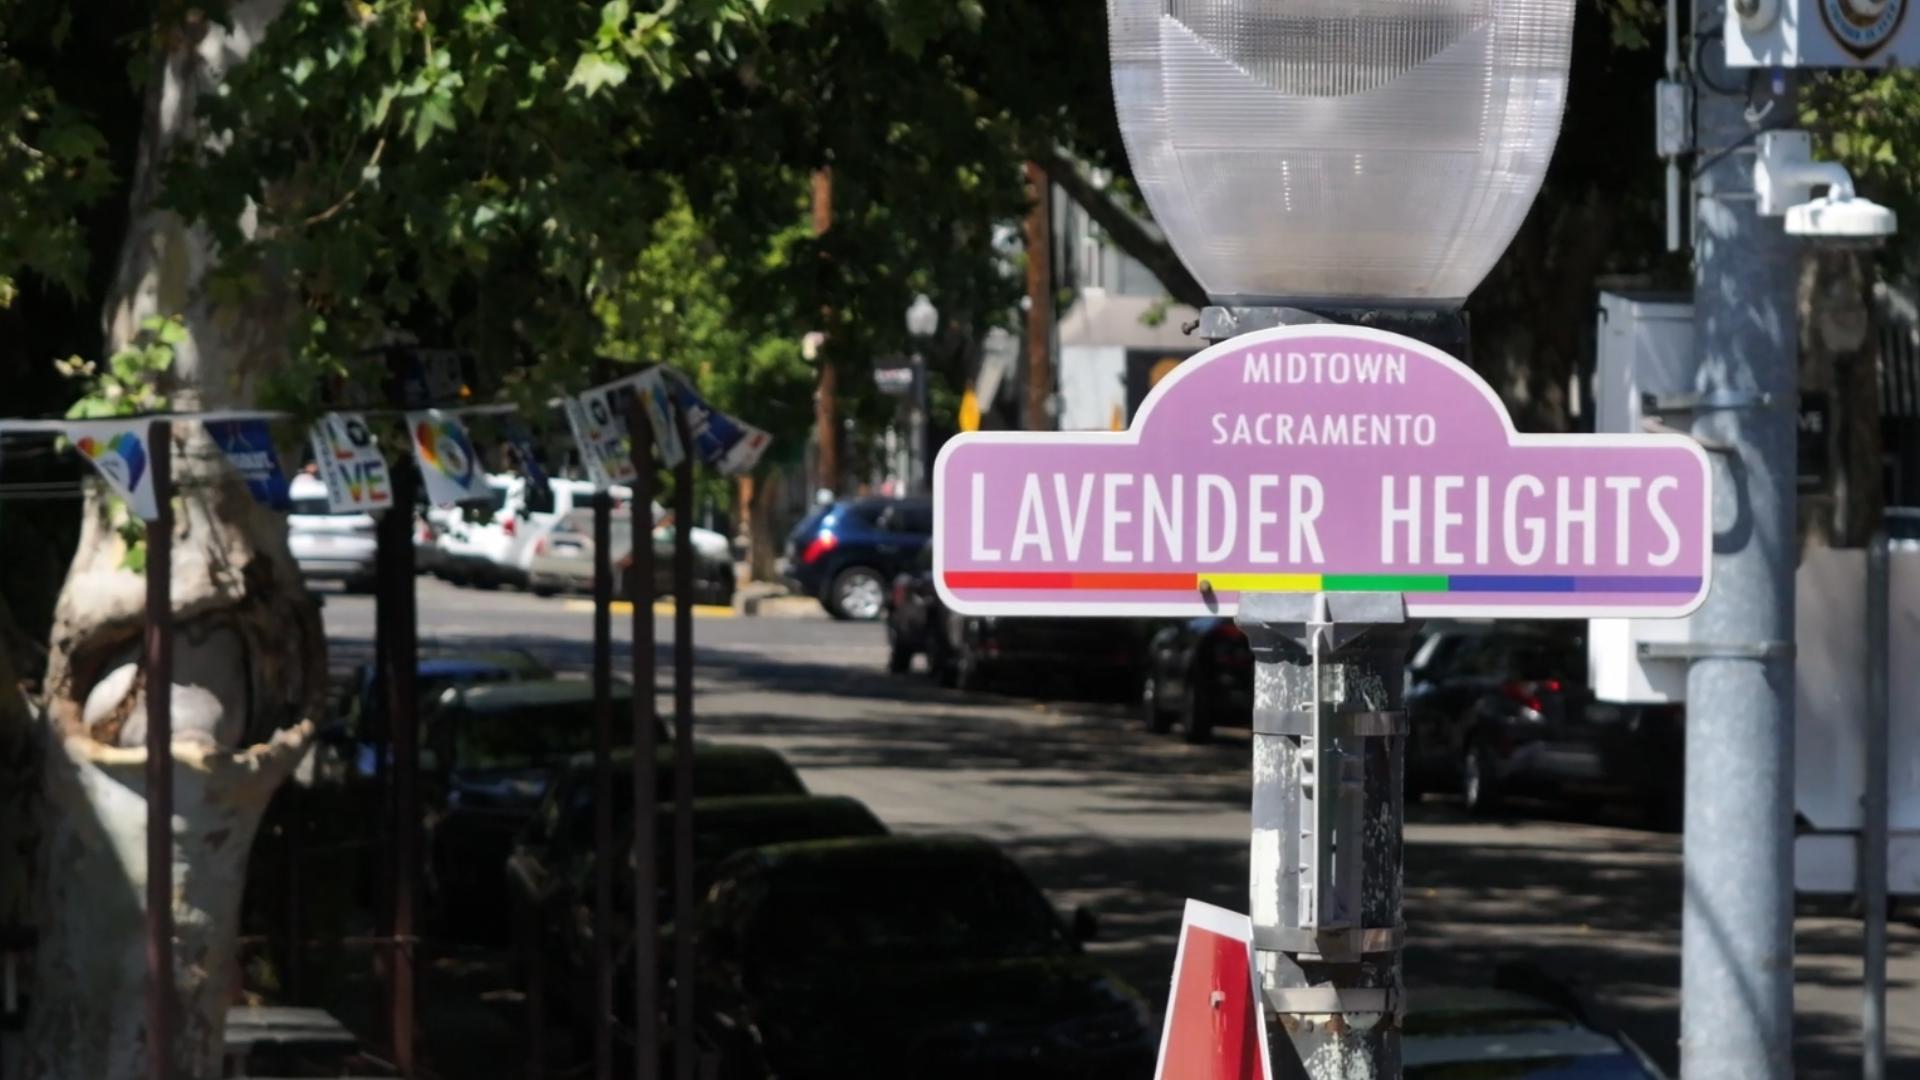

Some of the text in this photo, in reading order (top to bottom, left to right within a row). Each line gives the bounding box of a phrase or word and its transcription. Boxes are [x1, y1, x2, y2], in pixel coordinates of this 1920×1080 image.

[1243, 352, 1406, 384] MIDTOWN
[1211, 412, 1437, 446] SACRAMENTO
[970, 473, 1681, 567] LAVENDER HEIGHTS
